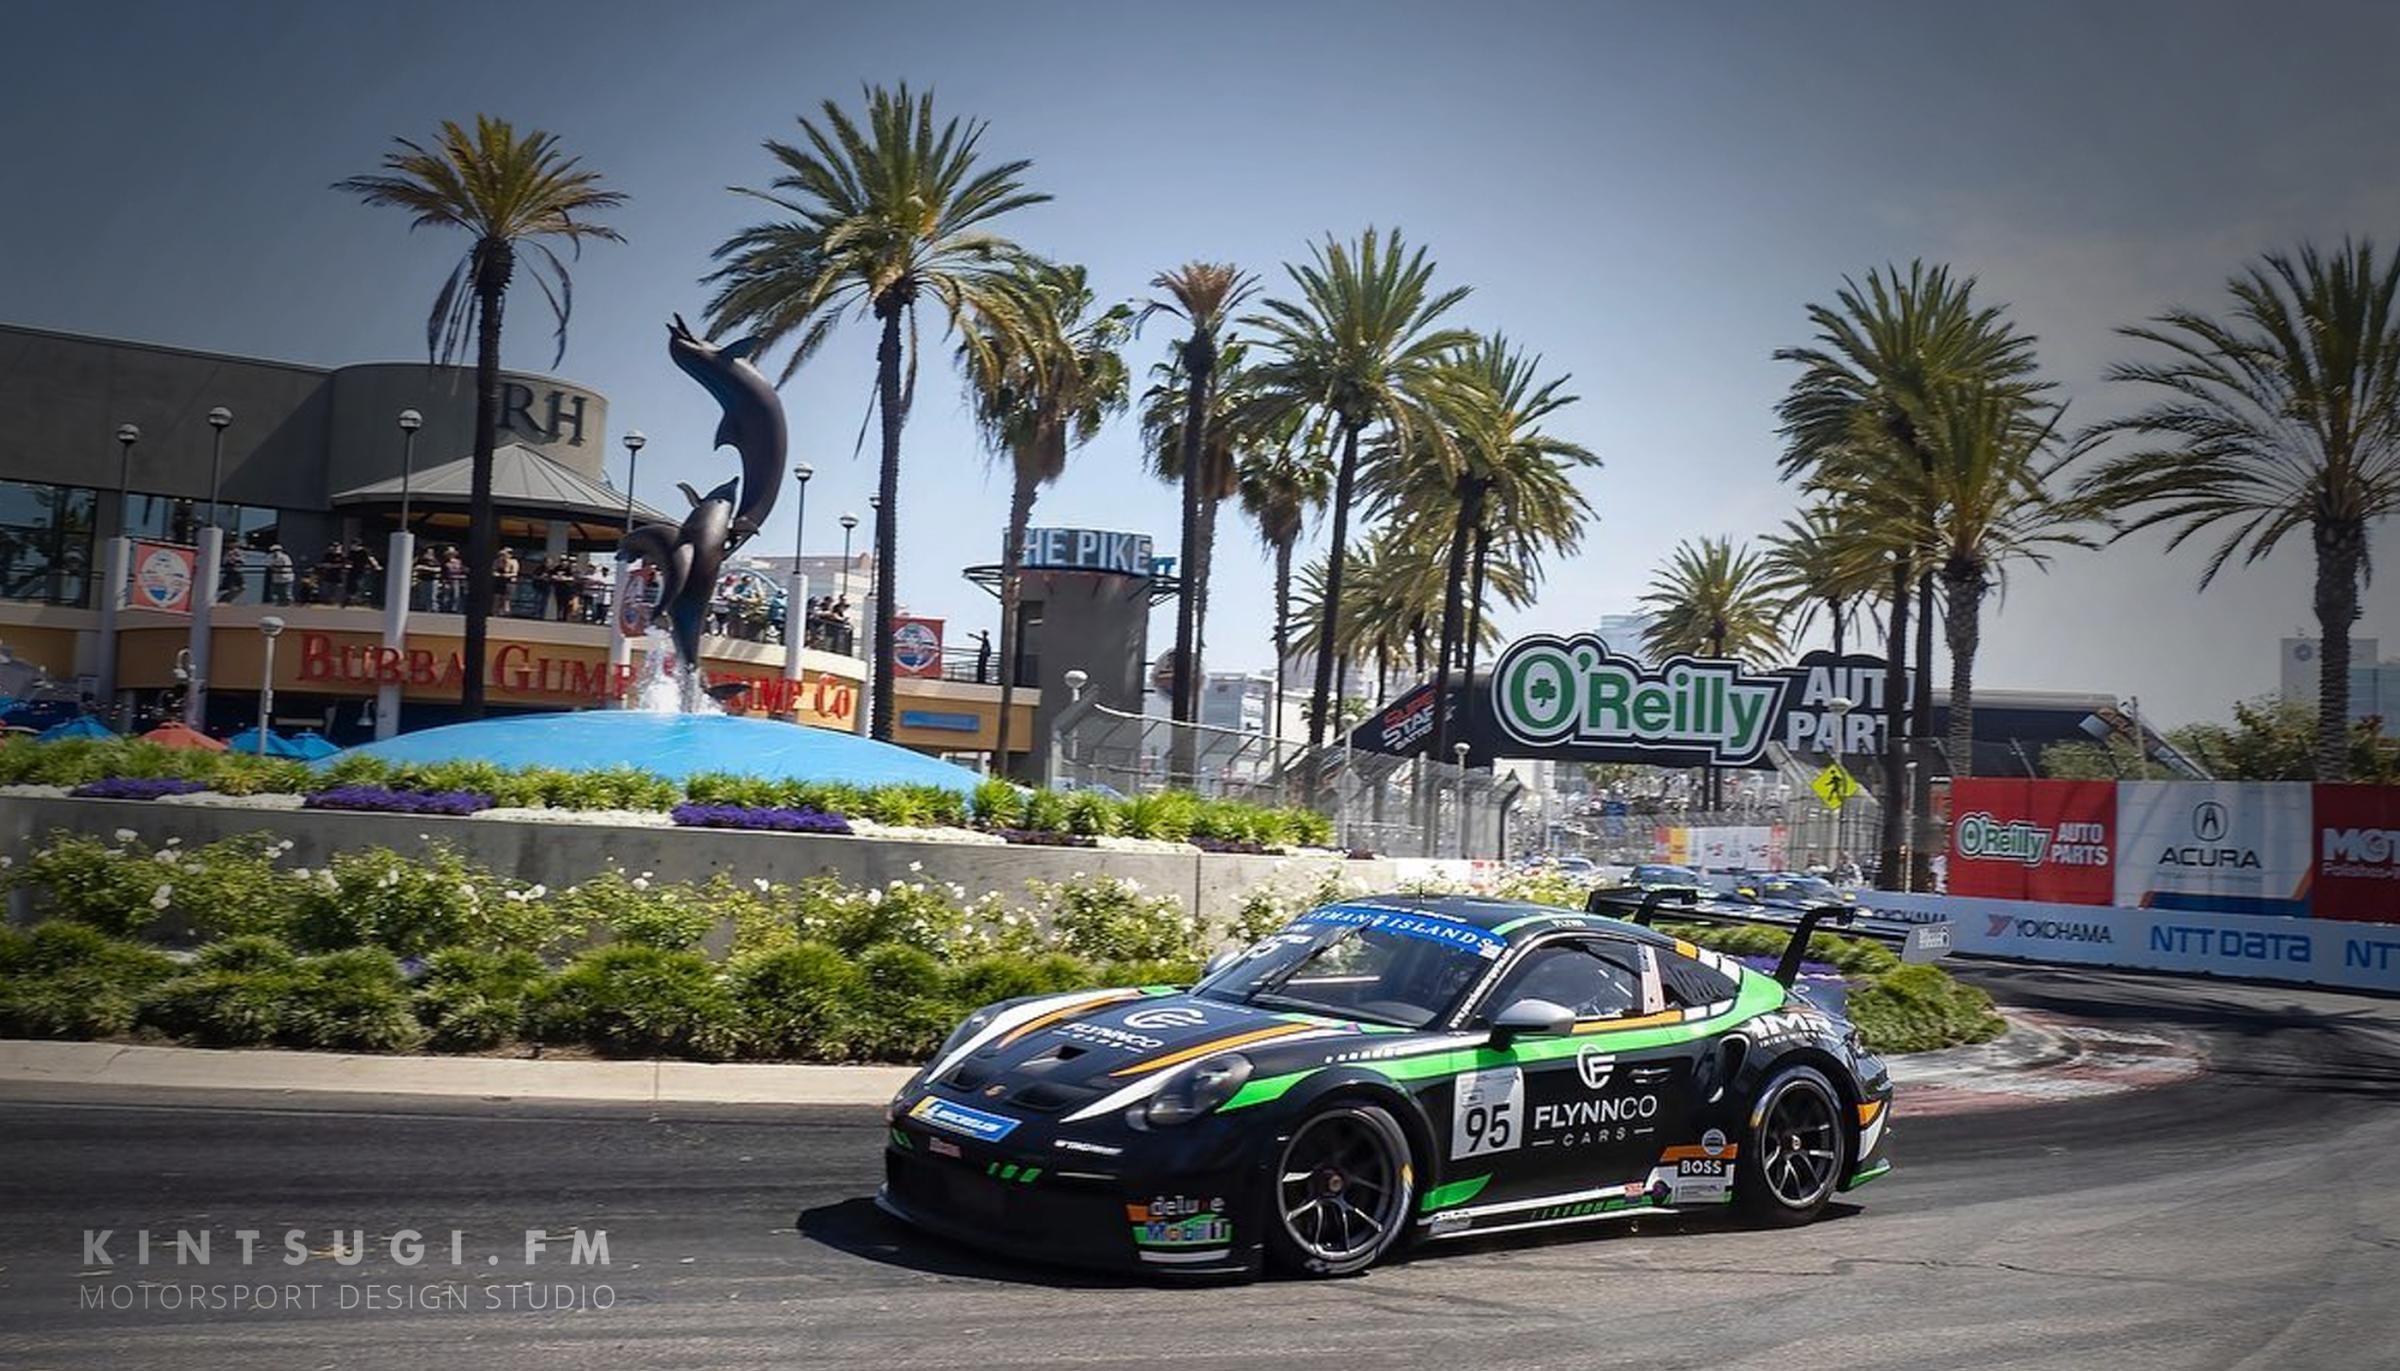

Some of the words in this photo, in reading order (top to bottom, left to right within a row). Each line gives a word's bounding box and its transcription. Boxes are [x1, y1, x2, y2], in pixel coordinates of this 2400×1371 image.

[497, 383, 587, 447] RH
[1076, 531, 1151, 576] PIKE
[1509, 651, 1765, 748] O'Reilly
[1962, 818, 2046, 860] O'Reilly
[2056, 823, 2103, 843] AUTO
[2051, 845, 2109, 866] PARTS
[2158, 847, 2262, 869] ACURA
[2014, 919, 2115, 945] YOKOHAMA
[2150, 925, 2215, 953] NTT
[1466, 1102, 1511, 1153] 95
[1534, 1095, 1657, 1131] FLYNNCO
[1562, 1127, 1626, 1148] CARS
[1681, 1159, 1723, 1174] BOSS
